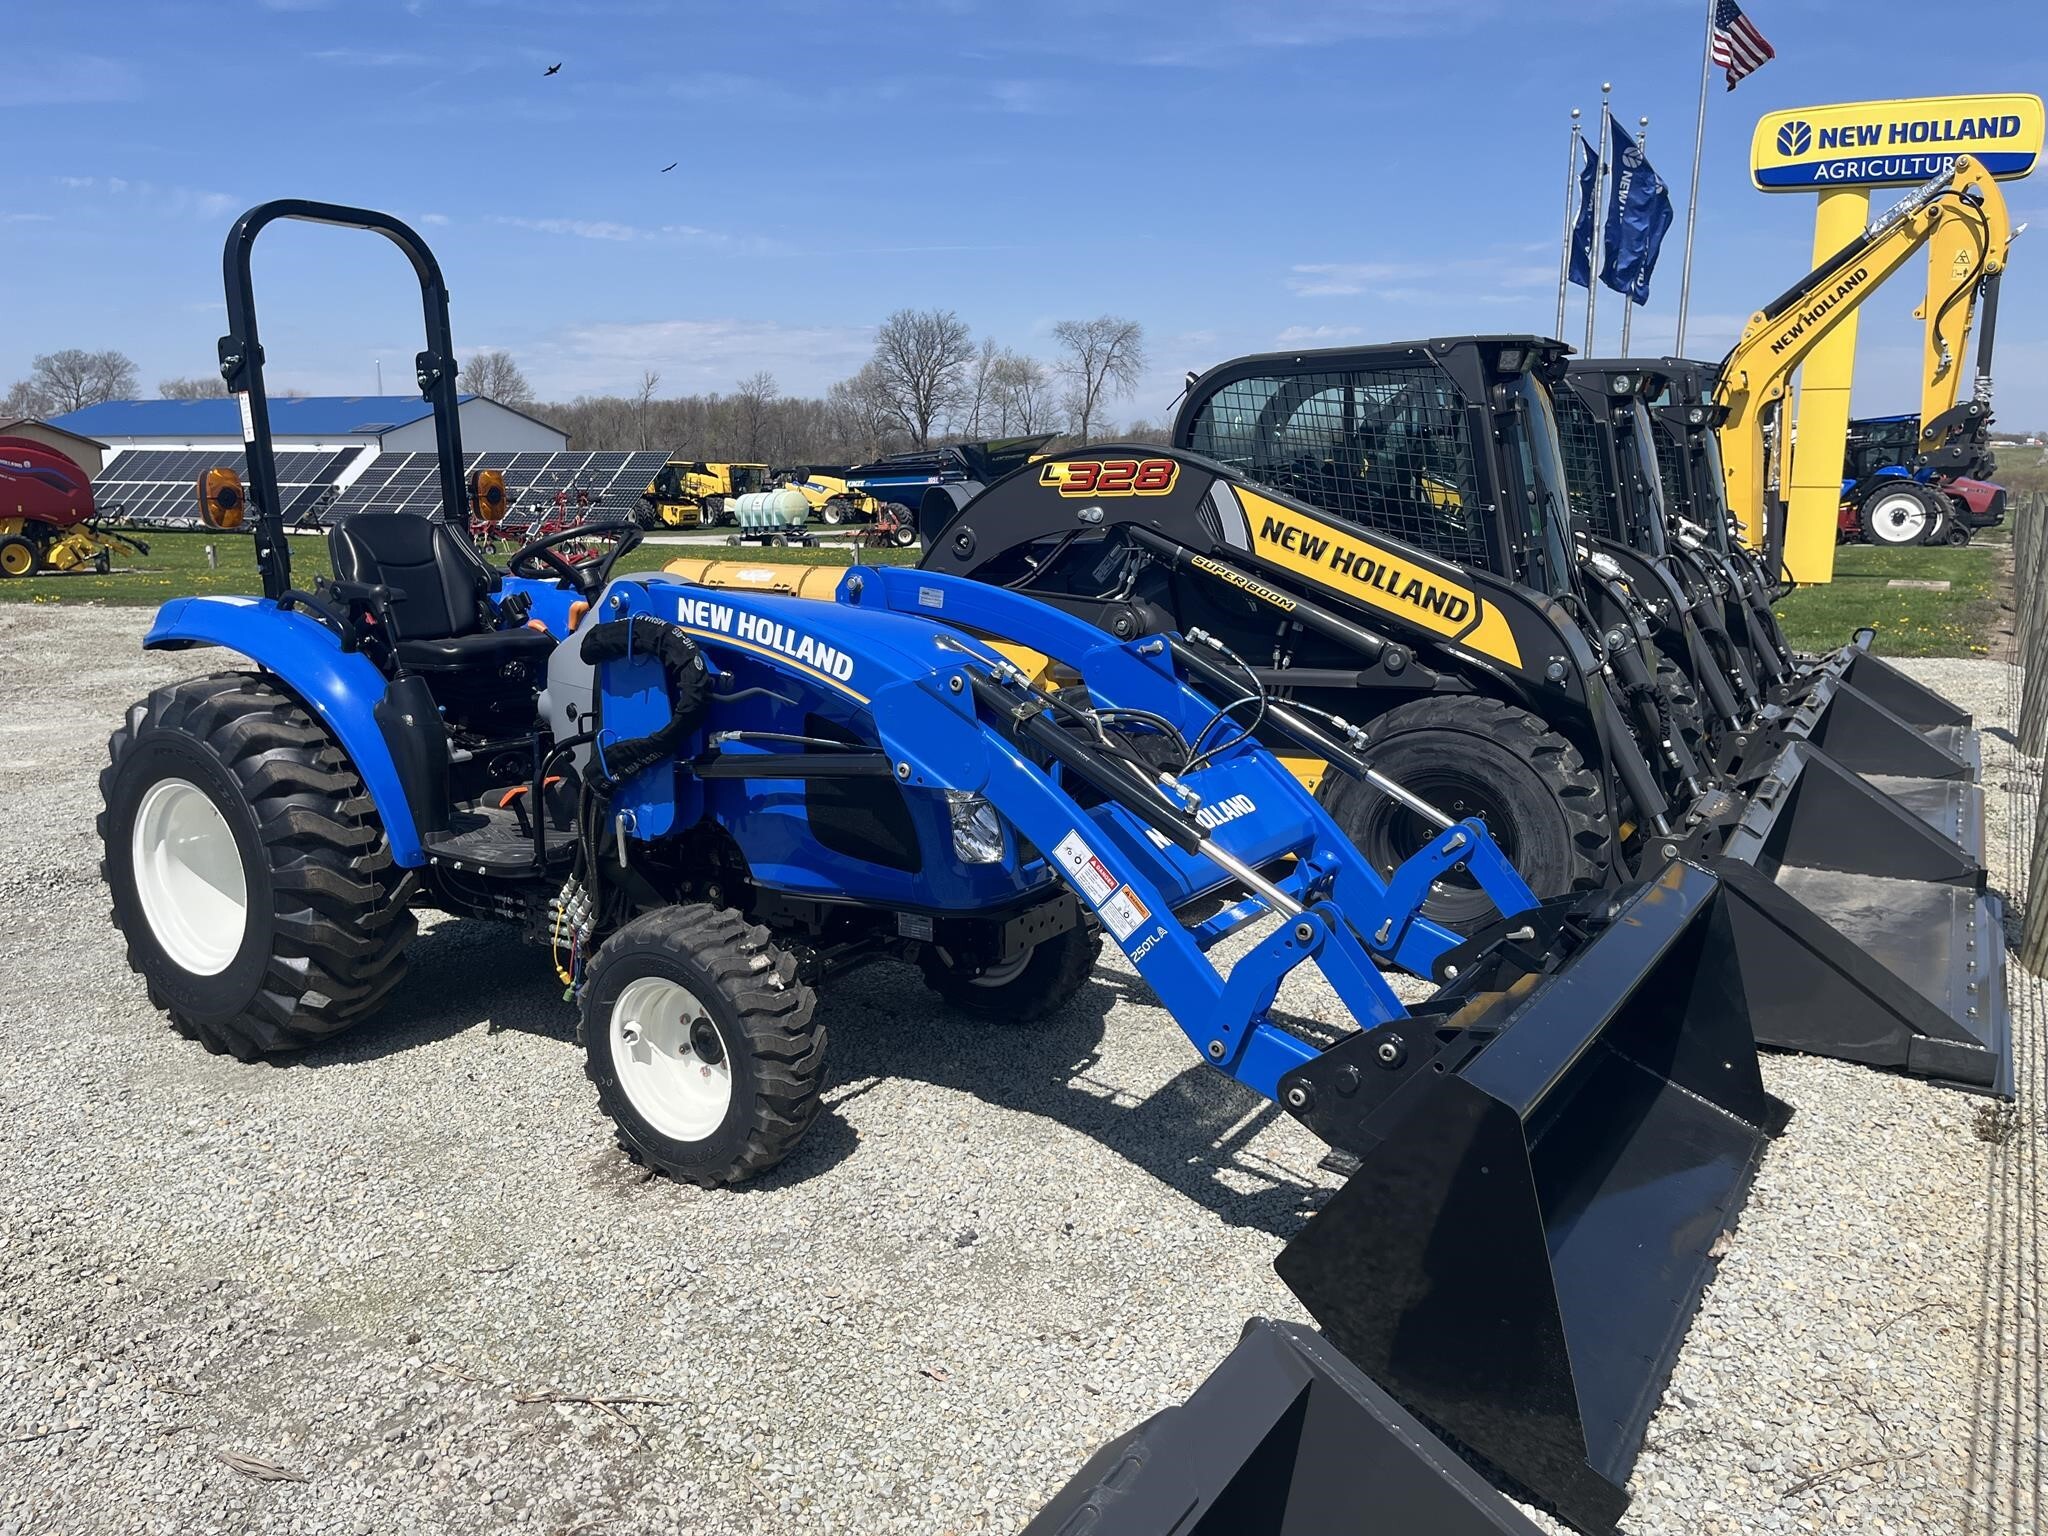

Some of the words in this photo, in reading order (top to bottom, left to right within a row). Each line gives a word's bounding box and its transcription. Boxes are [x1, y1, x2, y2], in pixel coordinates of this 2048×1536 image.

[1818, 124, 1883, 149] NEW
[1888, 115, 2021, 144] HOLLAND
[1814, 156, 1955, 180] AGRICULTUR
[1618, 170, 1633, 204] NEW
[1770, 322, 1804, 355] NEW
[1803, 268, 1868, 327] HOLLAND
[1040, 459, 1179, 496] L328
[1192, 556, 1247, 587] SUPER
[1245, 582, 1296, 611] BOOM
[1259, 515, 1329, 562] NEW
[1329, 546, 1470, 622] HOLLAND
[677, 597, 733, 632] NEW
[737, 612, 854, 681] HOLLAND
[1195, 794, 1256, 829] OLLAND
[1095, 862, 1116, 887] DANGER
[1130, 926, 1168, 963] 250TLA
